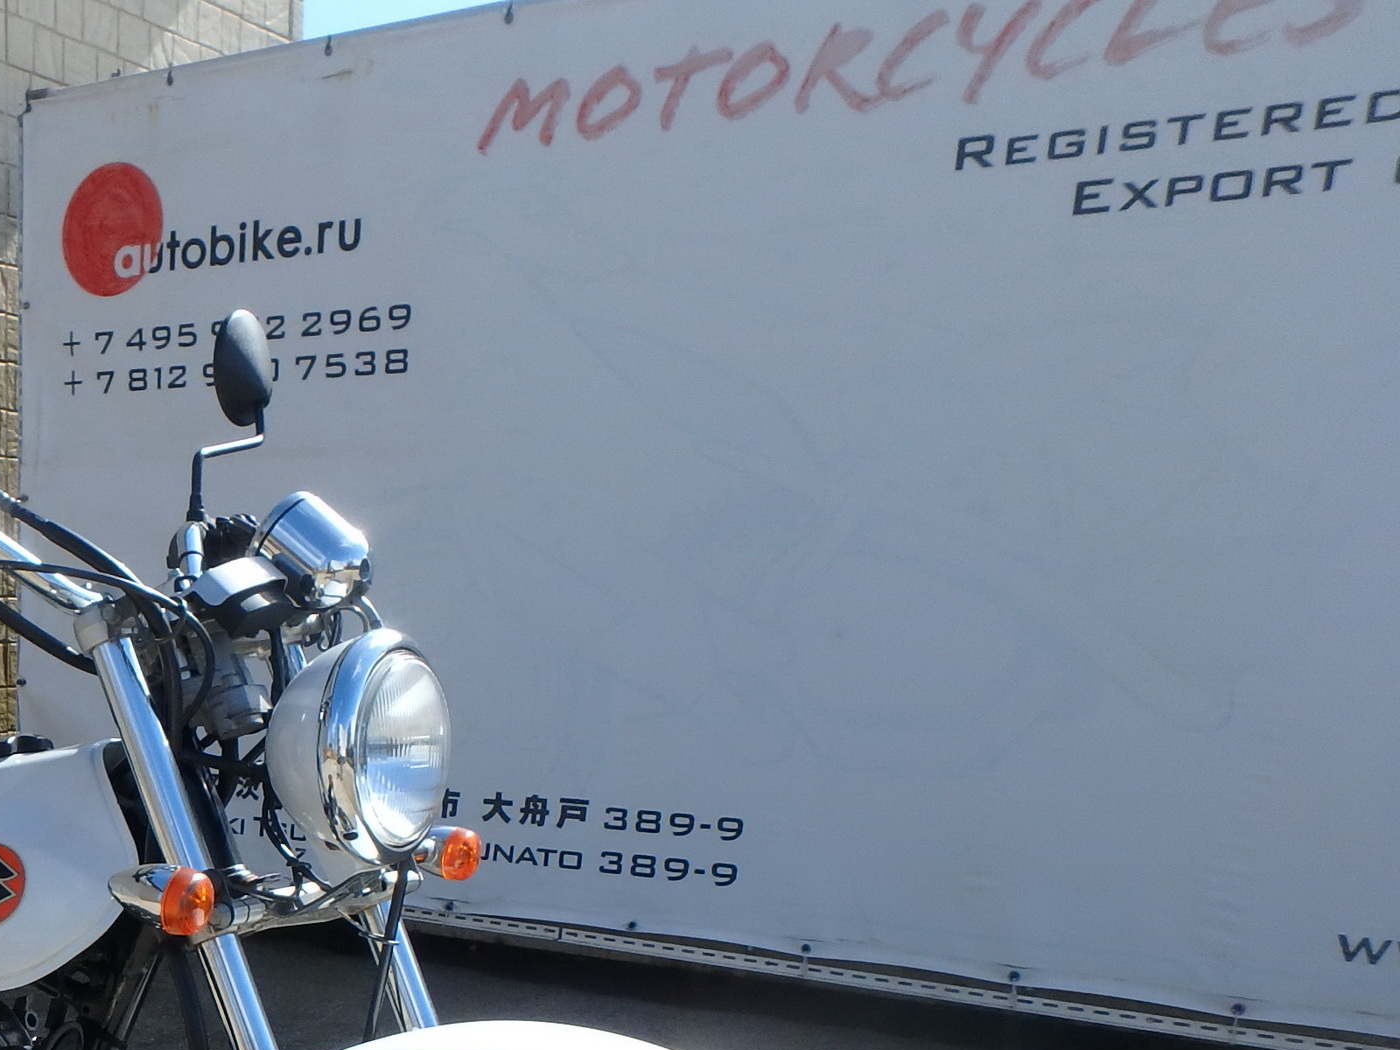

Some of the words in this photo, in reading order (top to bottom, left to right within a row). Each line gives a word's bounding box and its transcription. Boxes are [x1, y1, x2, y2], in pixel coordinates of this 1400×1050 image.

[1071, 157, 1354, 217] EXPORT
[113, 217, 362, 279] autobike.ru
[126, 323, 198, 352] 495
[301, 303, 412, 337] 2969
[128, 365, 187, 392] 812
[295, 348, 409, 381] 7538
[482, 791, 590, 828] 大舟戸
[603, 806, 744, 841] 389-9
[598, 850, 739, 887] 389-9
